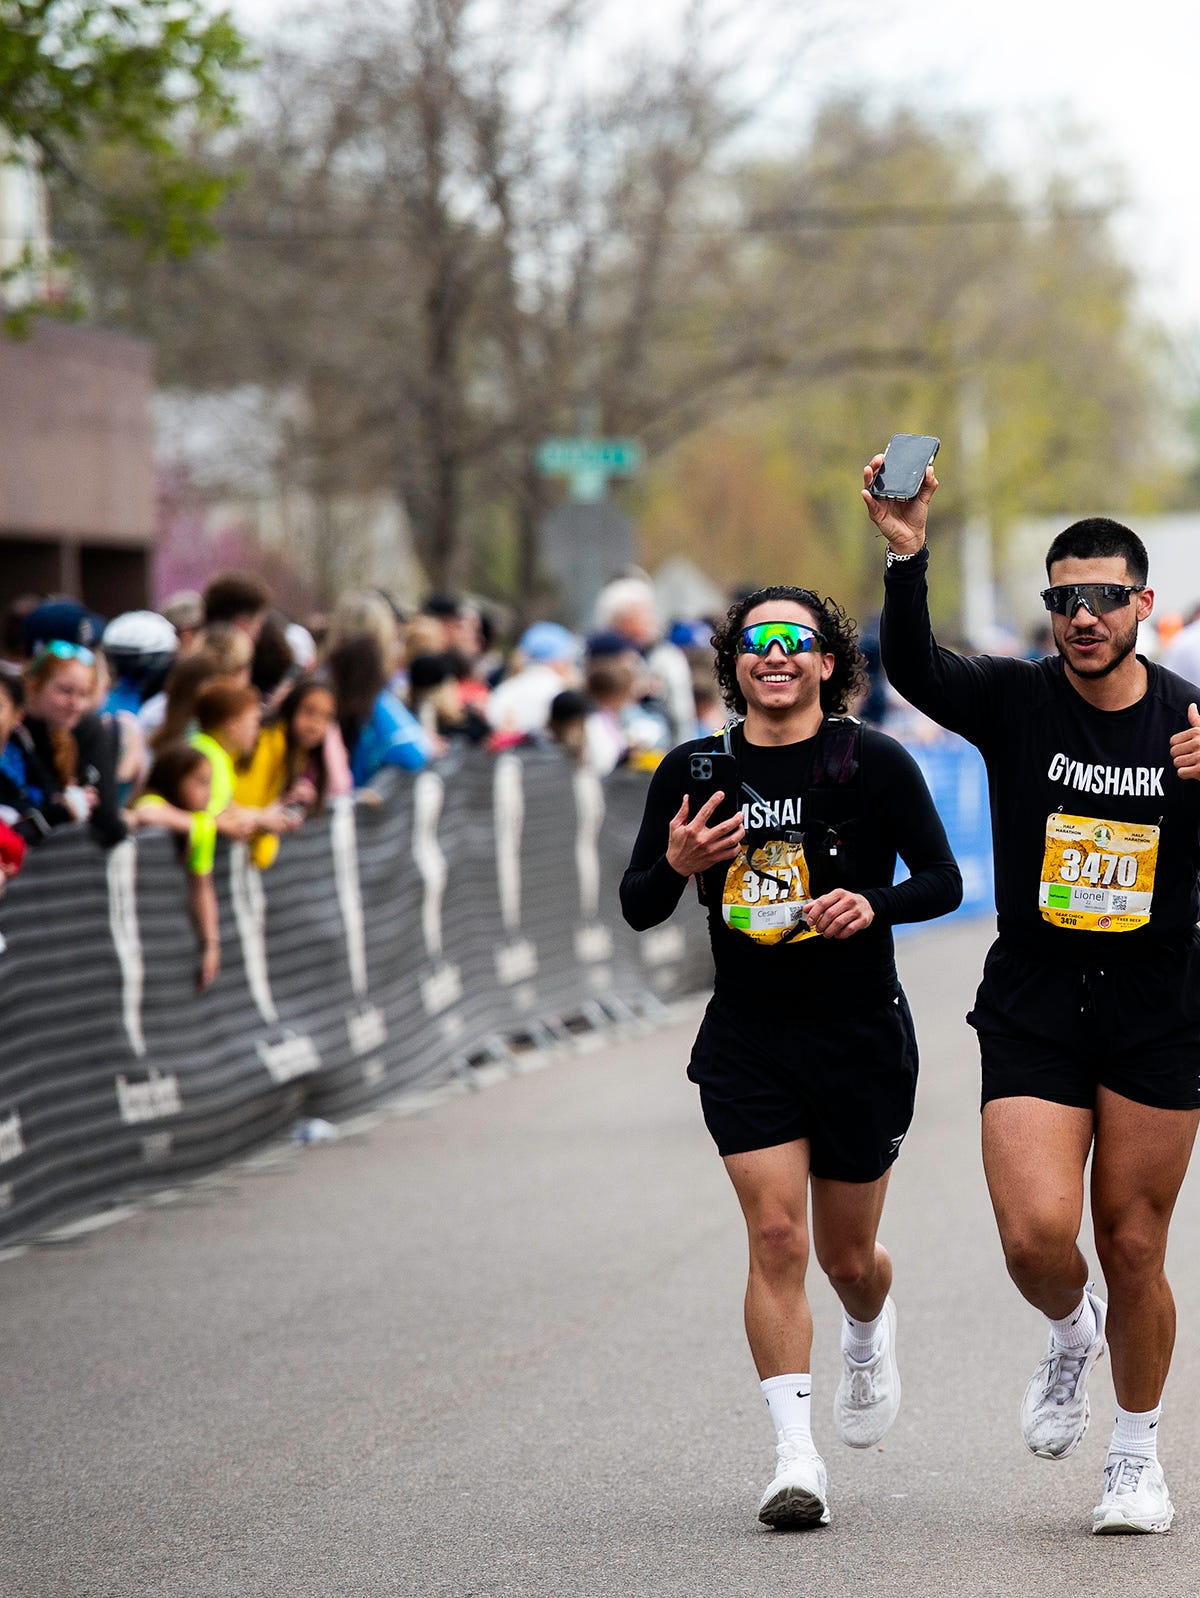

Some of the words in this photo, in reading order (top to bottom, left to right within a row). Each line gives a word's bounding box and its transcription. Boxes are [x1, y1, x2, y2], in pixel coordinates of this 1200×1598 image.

[1047, 753, 1165, 796] GYMSHARK
[1055, 828, 1082, 836] MARATHON
[1059, 848, 1138, 888] 3470
[1074, 890, 1105, 902] Lionel
[757, 910, 777, 918] Cesar
[1060, 917, 1078, 926] 3470
